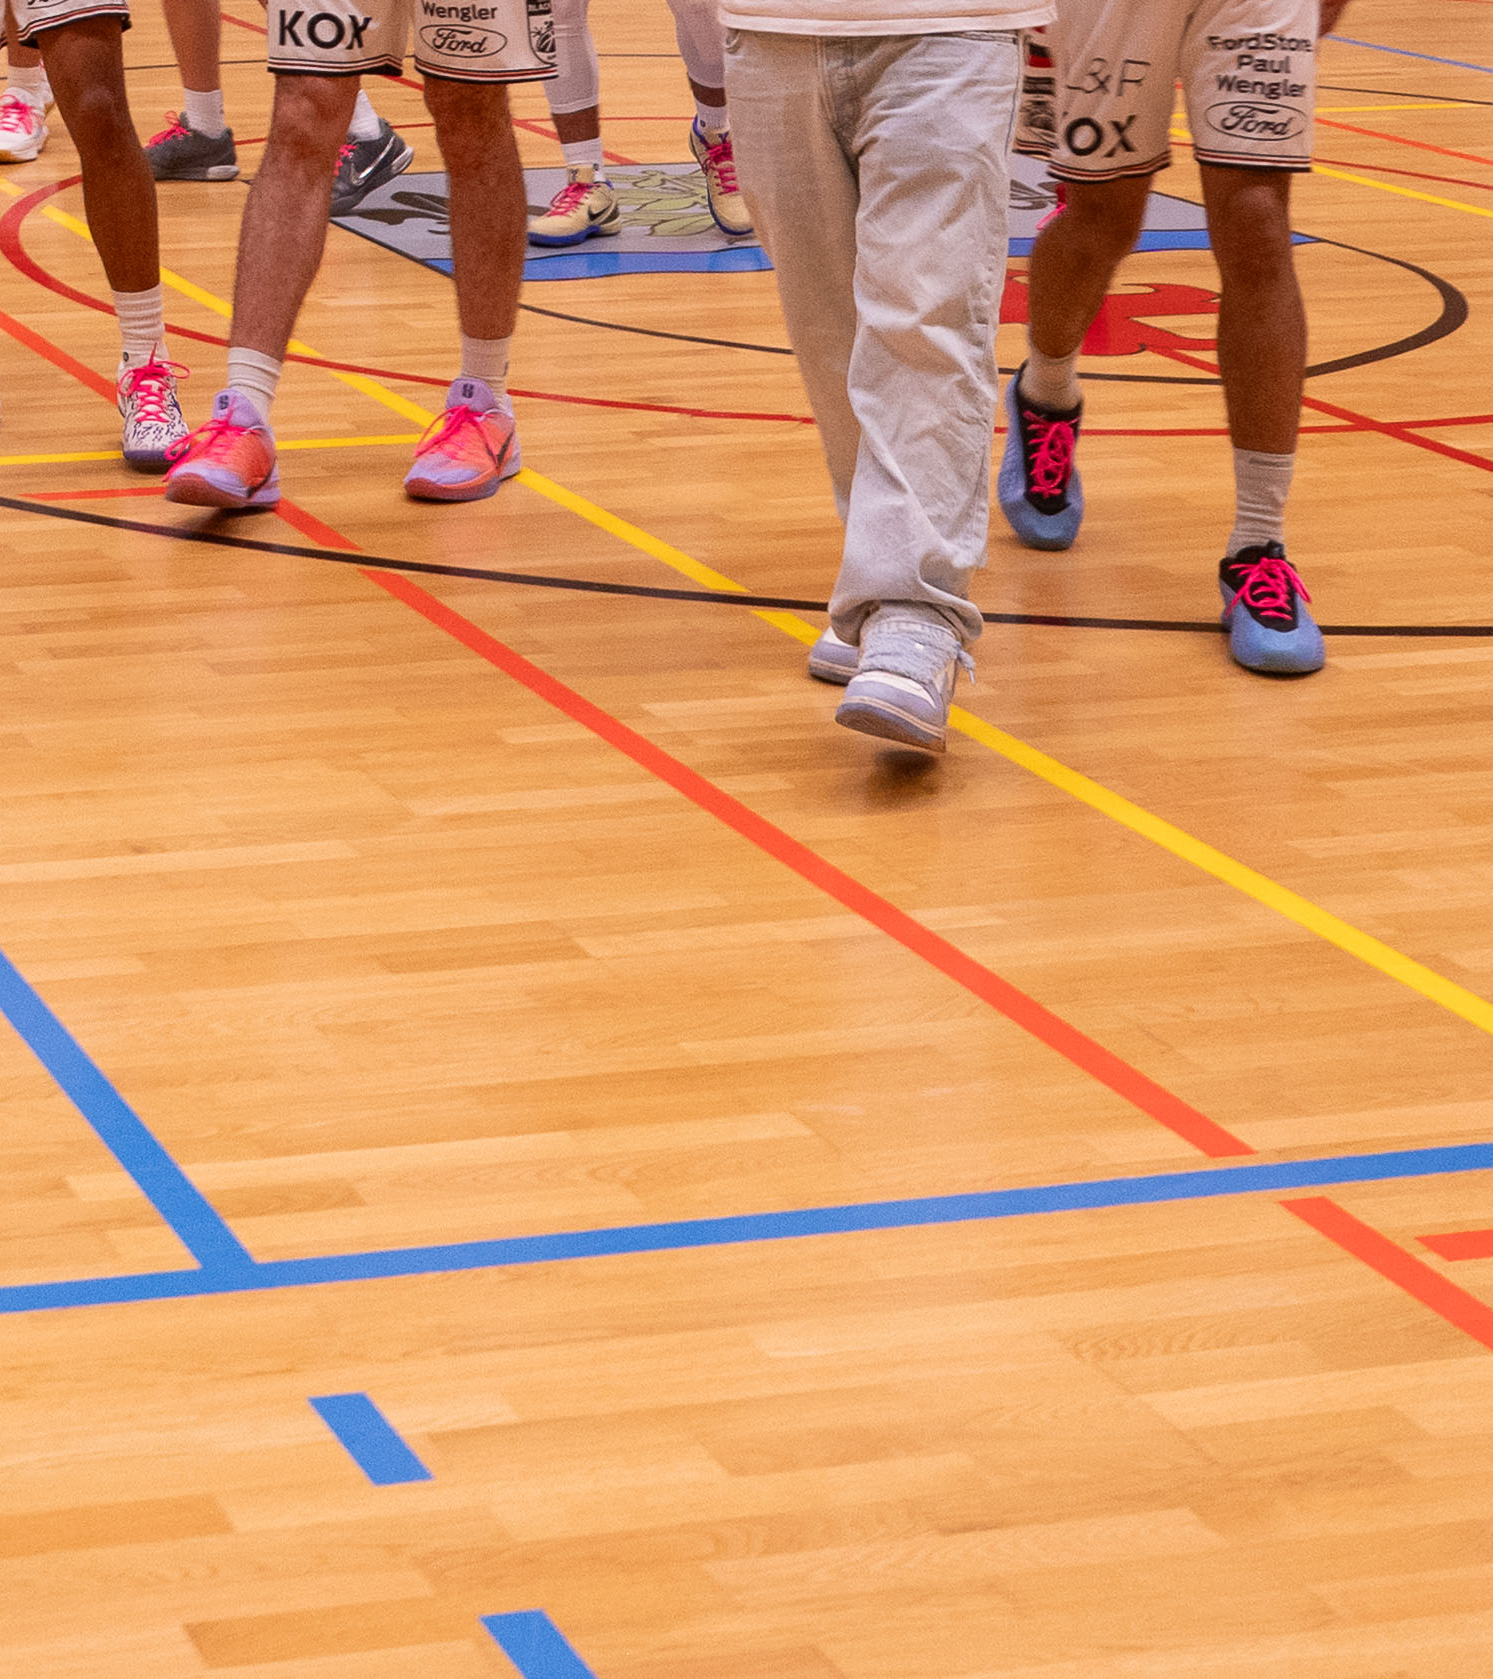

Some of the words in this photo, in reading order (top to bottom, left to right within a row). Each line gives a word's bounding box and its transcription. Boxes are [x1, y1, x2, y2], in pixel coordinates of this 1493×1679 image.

[421, 0, 498, 22] Wengler
[278, 9, 372, 50] KOX
[432, 27, 488, 54] Ford
[1237, 54, 1291, 73] Paul
[1216, 74, 1307, 100] Wengler
[1220, 104, 1294, 136] Ford
[1064, 114, 1136, 158] OX
